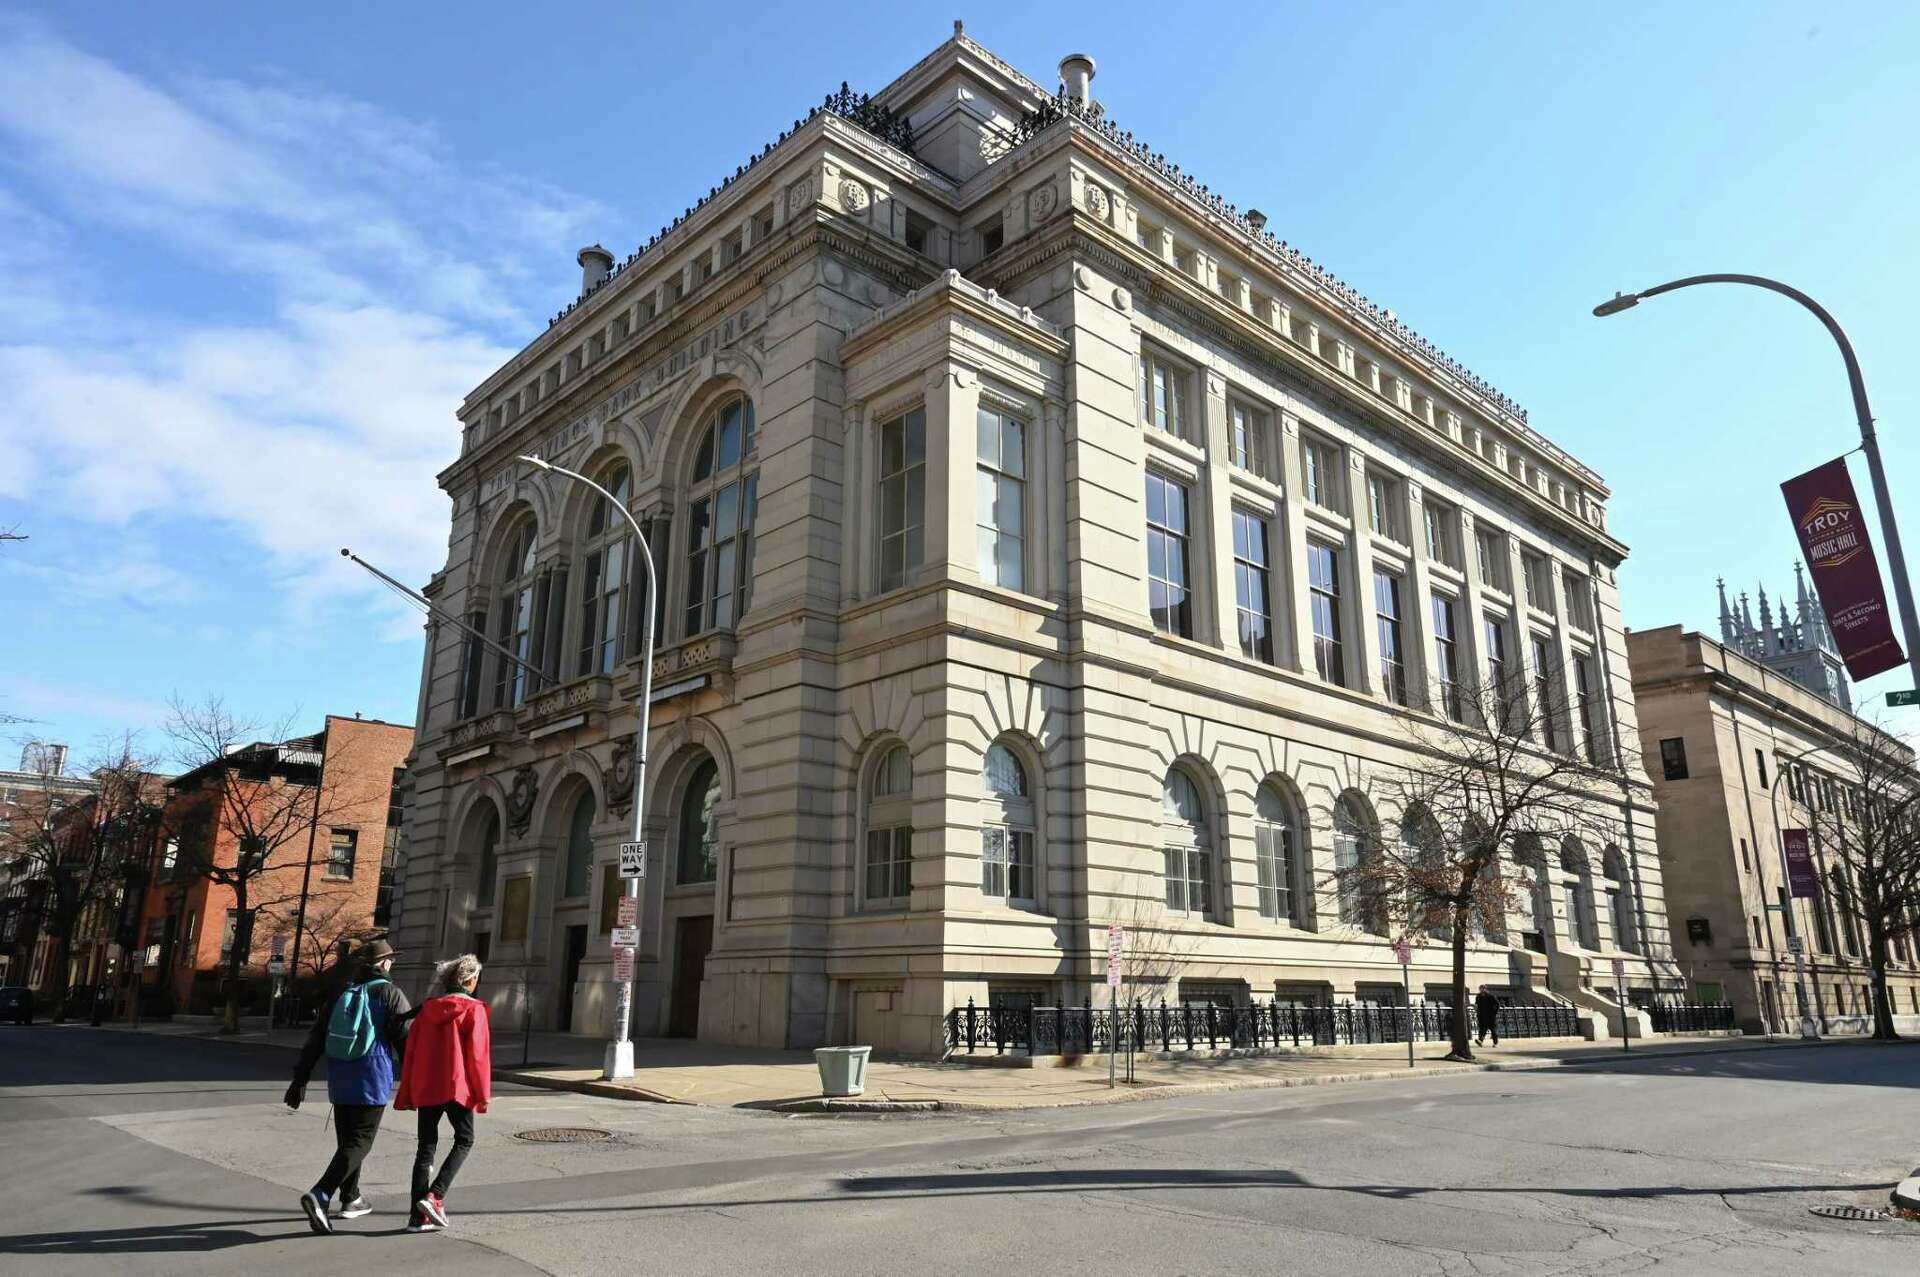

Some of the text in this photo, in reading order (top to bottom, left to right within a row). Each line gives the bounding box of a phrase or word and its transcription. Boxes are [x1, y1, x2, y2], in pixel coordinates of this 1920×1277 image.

[531, 417, 590, 465] AVINGS
[656, 310, 751, 386] BUILDING
[1804, 511, 1850, 535] TROY
[1810, 538, 1838, 561] MUSIC
[1836, 531, 1859, 551] HALL
[622, 845, 643, 855] ONE
[622, 854, 643, 865] WAY
